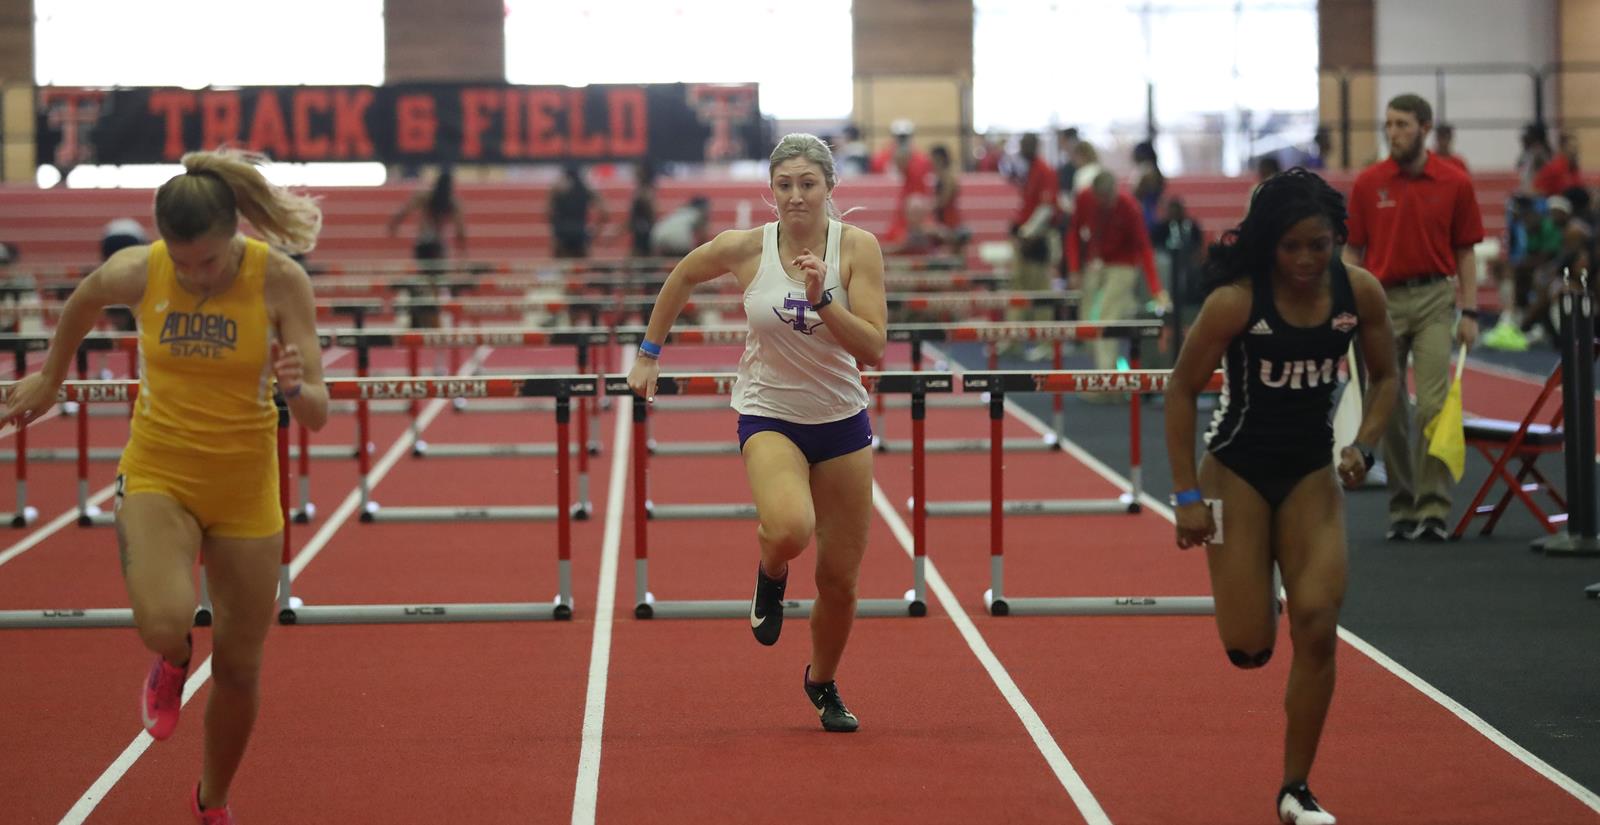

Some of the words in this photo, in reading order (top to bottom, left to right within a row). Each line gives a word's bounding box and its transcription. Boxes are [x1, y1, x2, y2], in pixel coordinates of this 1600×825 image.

[148, 89, 375, 160] TRACK
[461, 89, 648, 159] FIELD
[160, 311, 238, 350] Angelo
[169, 344, 225, 359] STATE
[359, 382, 428, 399] TEXAS
[433, 380, 487, 398] TECH
[571, 382, 595, 392] UCS
[925, 379, 949, 388] UCS
[964, 379, 989, 388] UCS
[1072, 374, 1141, 391] TEXAS
[74, 385, 128, 402] TECH
[1115, 597, 1156, 606] UCS
[404, 606, 446, 616] UCS
